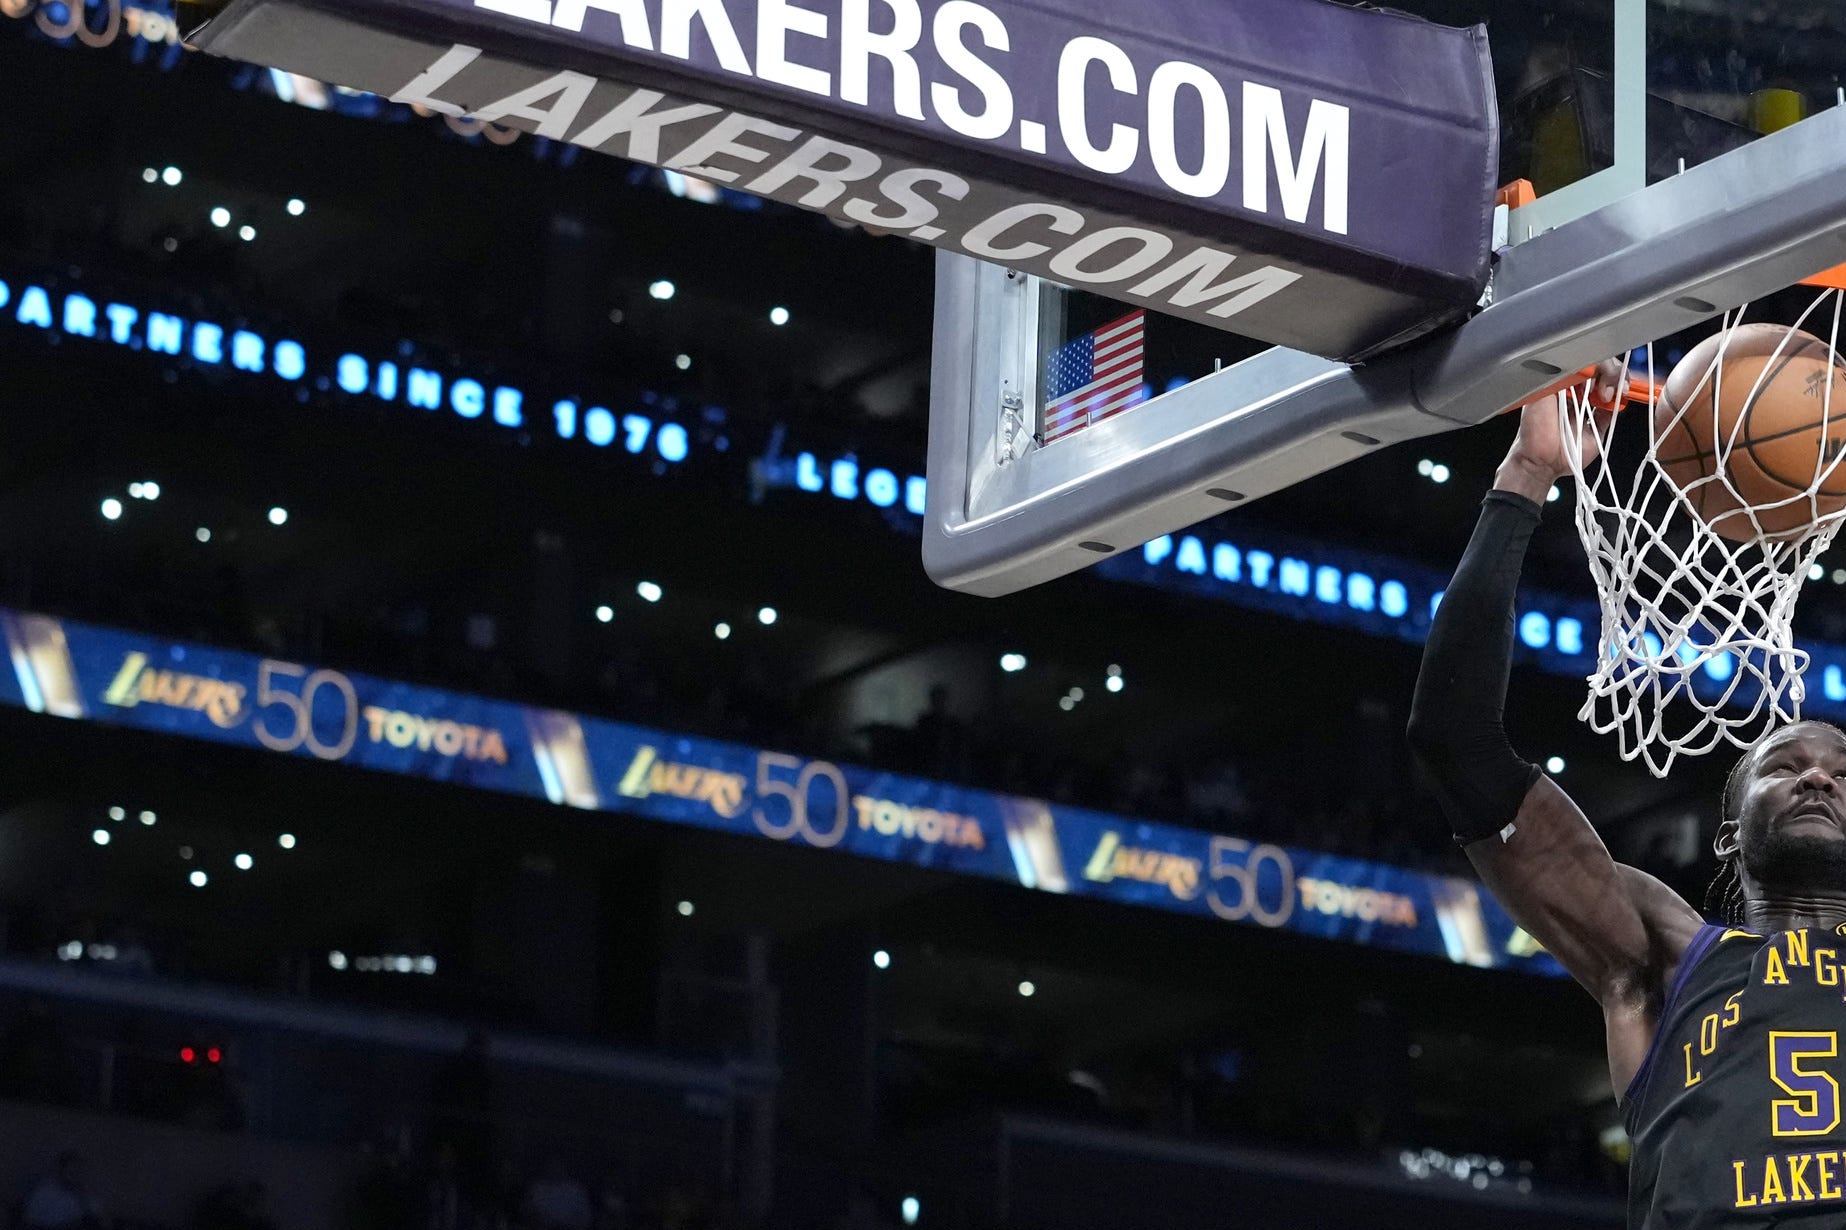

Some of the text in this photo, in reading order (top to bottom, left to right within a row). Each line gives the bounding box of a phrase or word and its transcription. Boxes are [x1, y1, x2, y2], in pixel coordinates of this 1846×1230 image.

[475, 0, 1349, 235] KERS.COM
[390, 44, 1303, 318] LAKERS.COM
[339, 355, 522, 427] SINCE
[1144, 534, 1407, 617] PARTNERS
[253, 658, 358, 760] 50
[364, 705, 507, 765] TOYOTA
[753, 750, 848, 848] 50
[852, 795, 985, 850] TOYOTA
[1206, 834, 1294, 928] 50
[1298, 877, 1418, 928] TOYOTA
[1683, 989, 1744, 1088] LOS
[1769, 1031, 1840, 1137] 5
